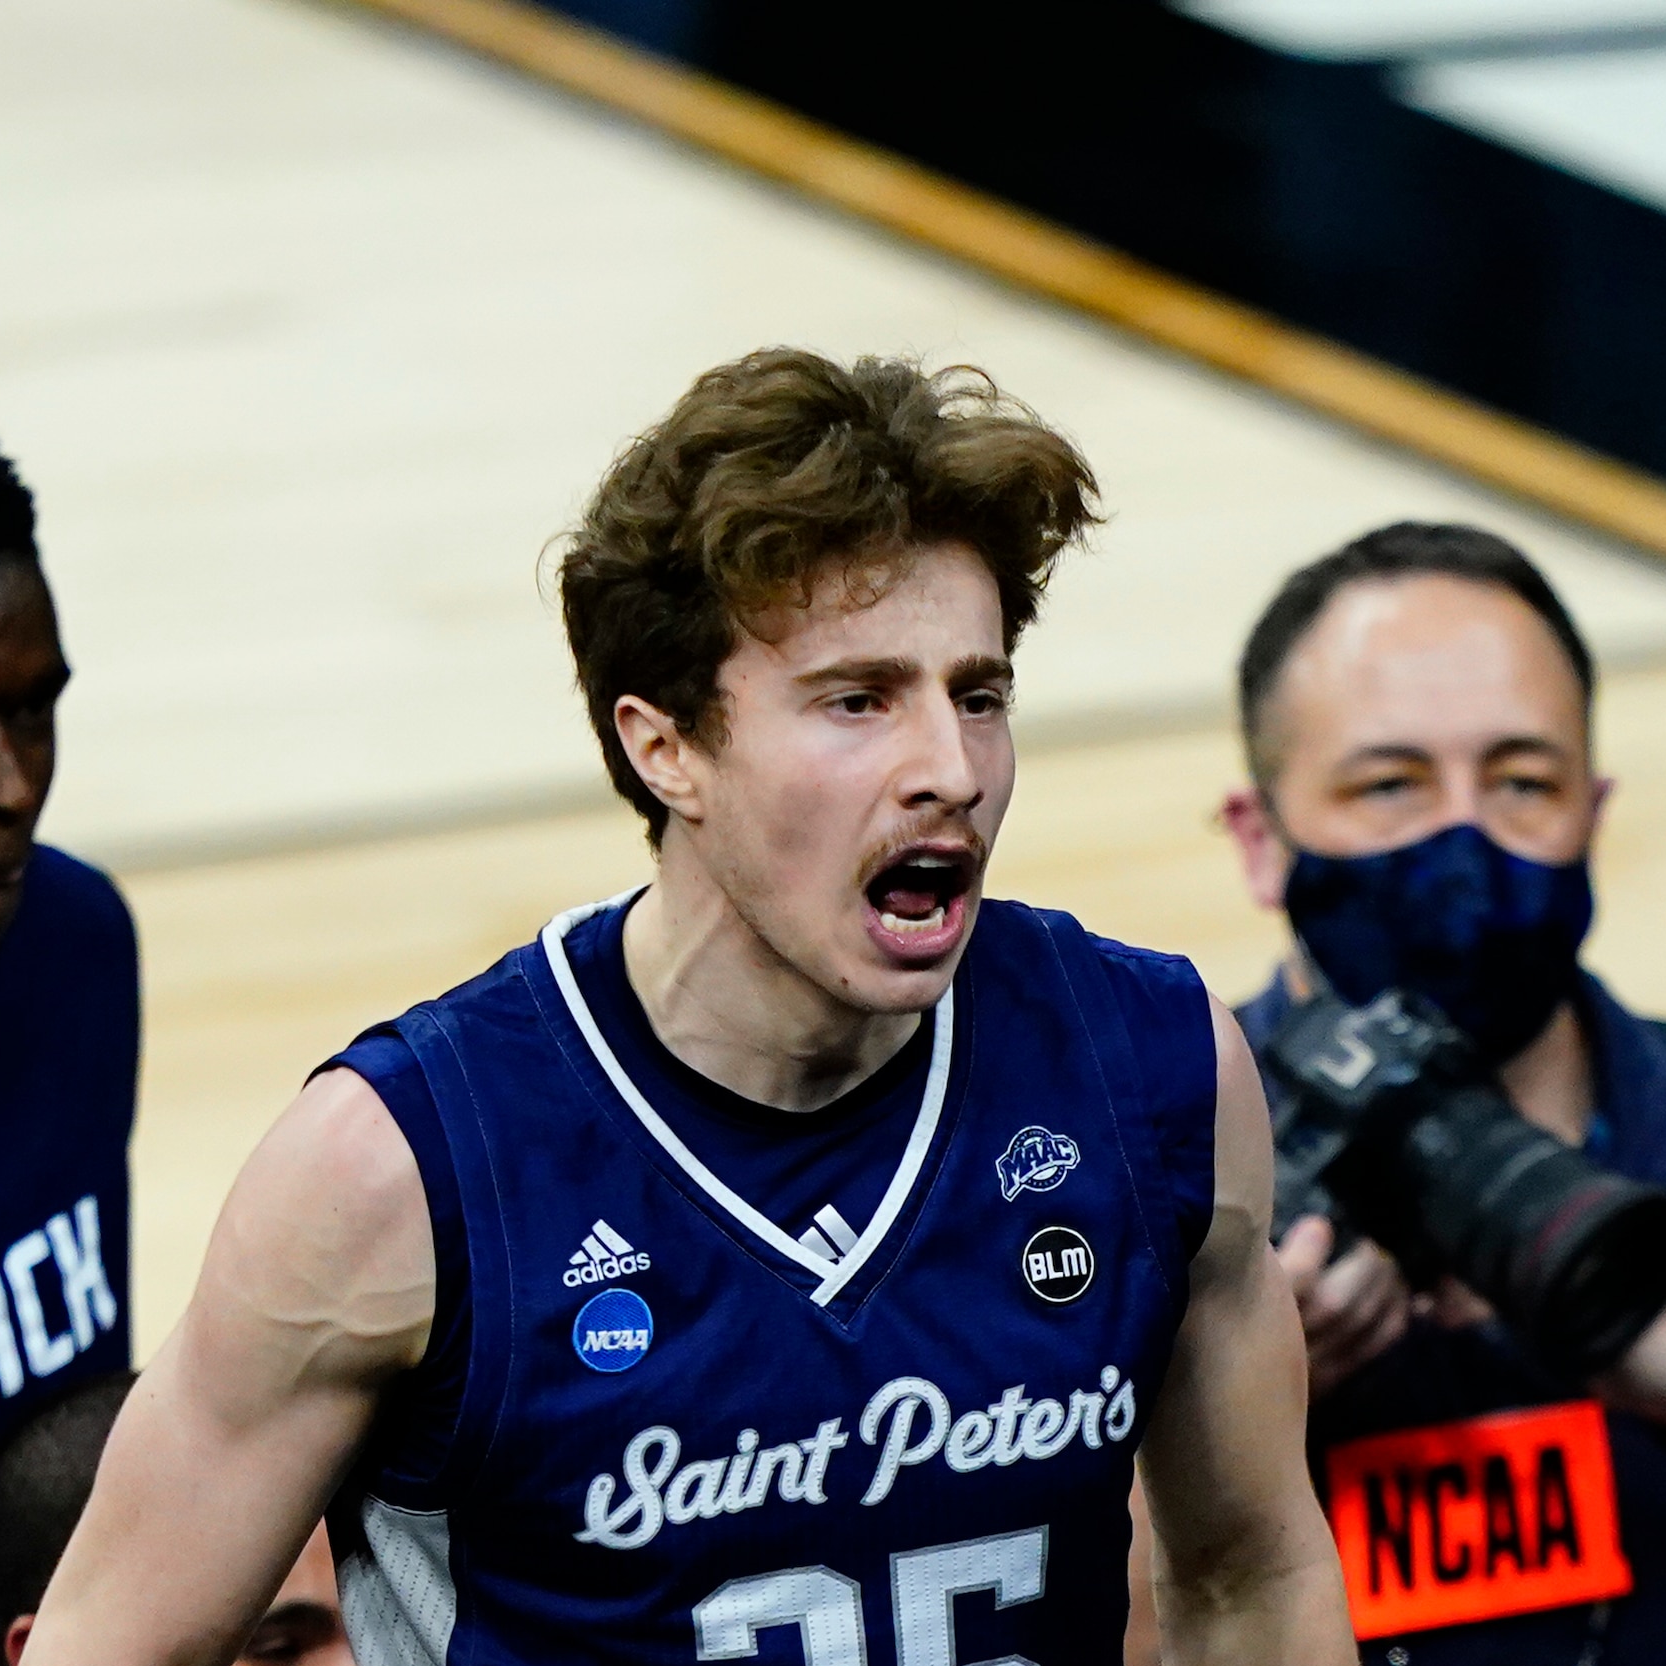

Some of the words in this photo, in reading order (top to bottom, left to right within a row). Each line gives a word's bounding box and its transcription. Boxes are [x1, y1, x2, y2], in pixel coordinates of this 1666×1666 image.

[997, 1136, 1080, 1199] MAAC
[563, 1249, 651, 1287] adidas
[1028, 1247, 1088, 1281] BLM
[582, 1329, 649, 1352] NCAA
[575, 1417, 849, 1549] Saint
[858, 1365, 1136, 1508] Peter's
[1363, 1445, 1582, 1595] NCAA
